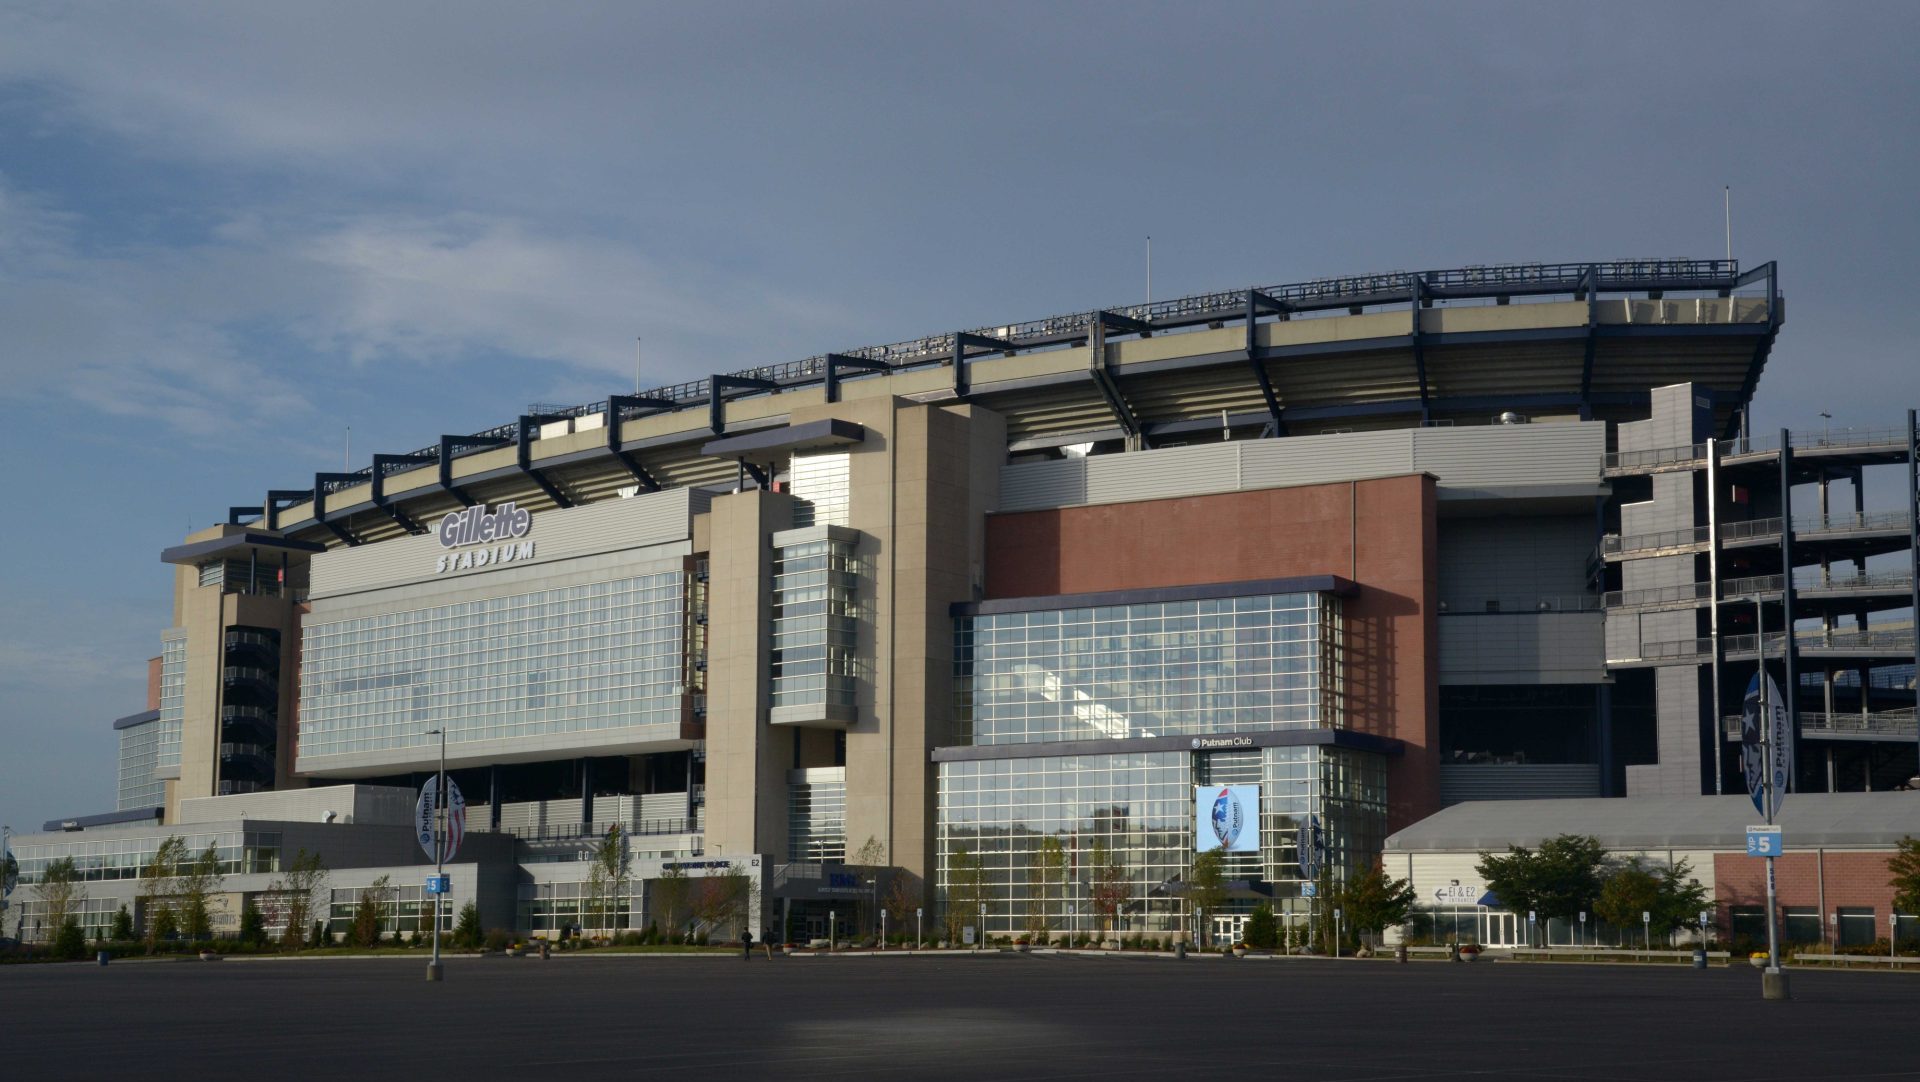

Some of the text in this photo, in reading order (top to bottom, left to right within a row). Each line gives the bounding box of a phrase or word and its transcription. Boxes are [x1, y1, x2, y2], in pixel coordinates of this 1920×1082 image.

[440, 501, 529, 548] Gillette
[436, 541, 535, 573] STADIUM
[1201, 736, 1253, 747] Putnam Club
[1775, 705, 1784, 768] Putnam
[422, 791, 430, 832] Putnam
[1748, 836, 1770, 853] VIP 5
[431, 880, 436, 891] 5
[1458, 886, 1464, 897] &
[1466, 886, 1475, 897] E2
